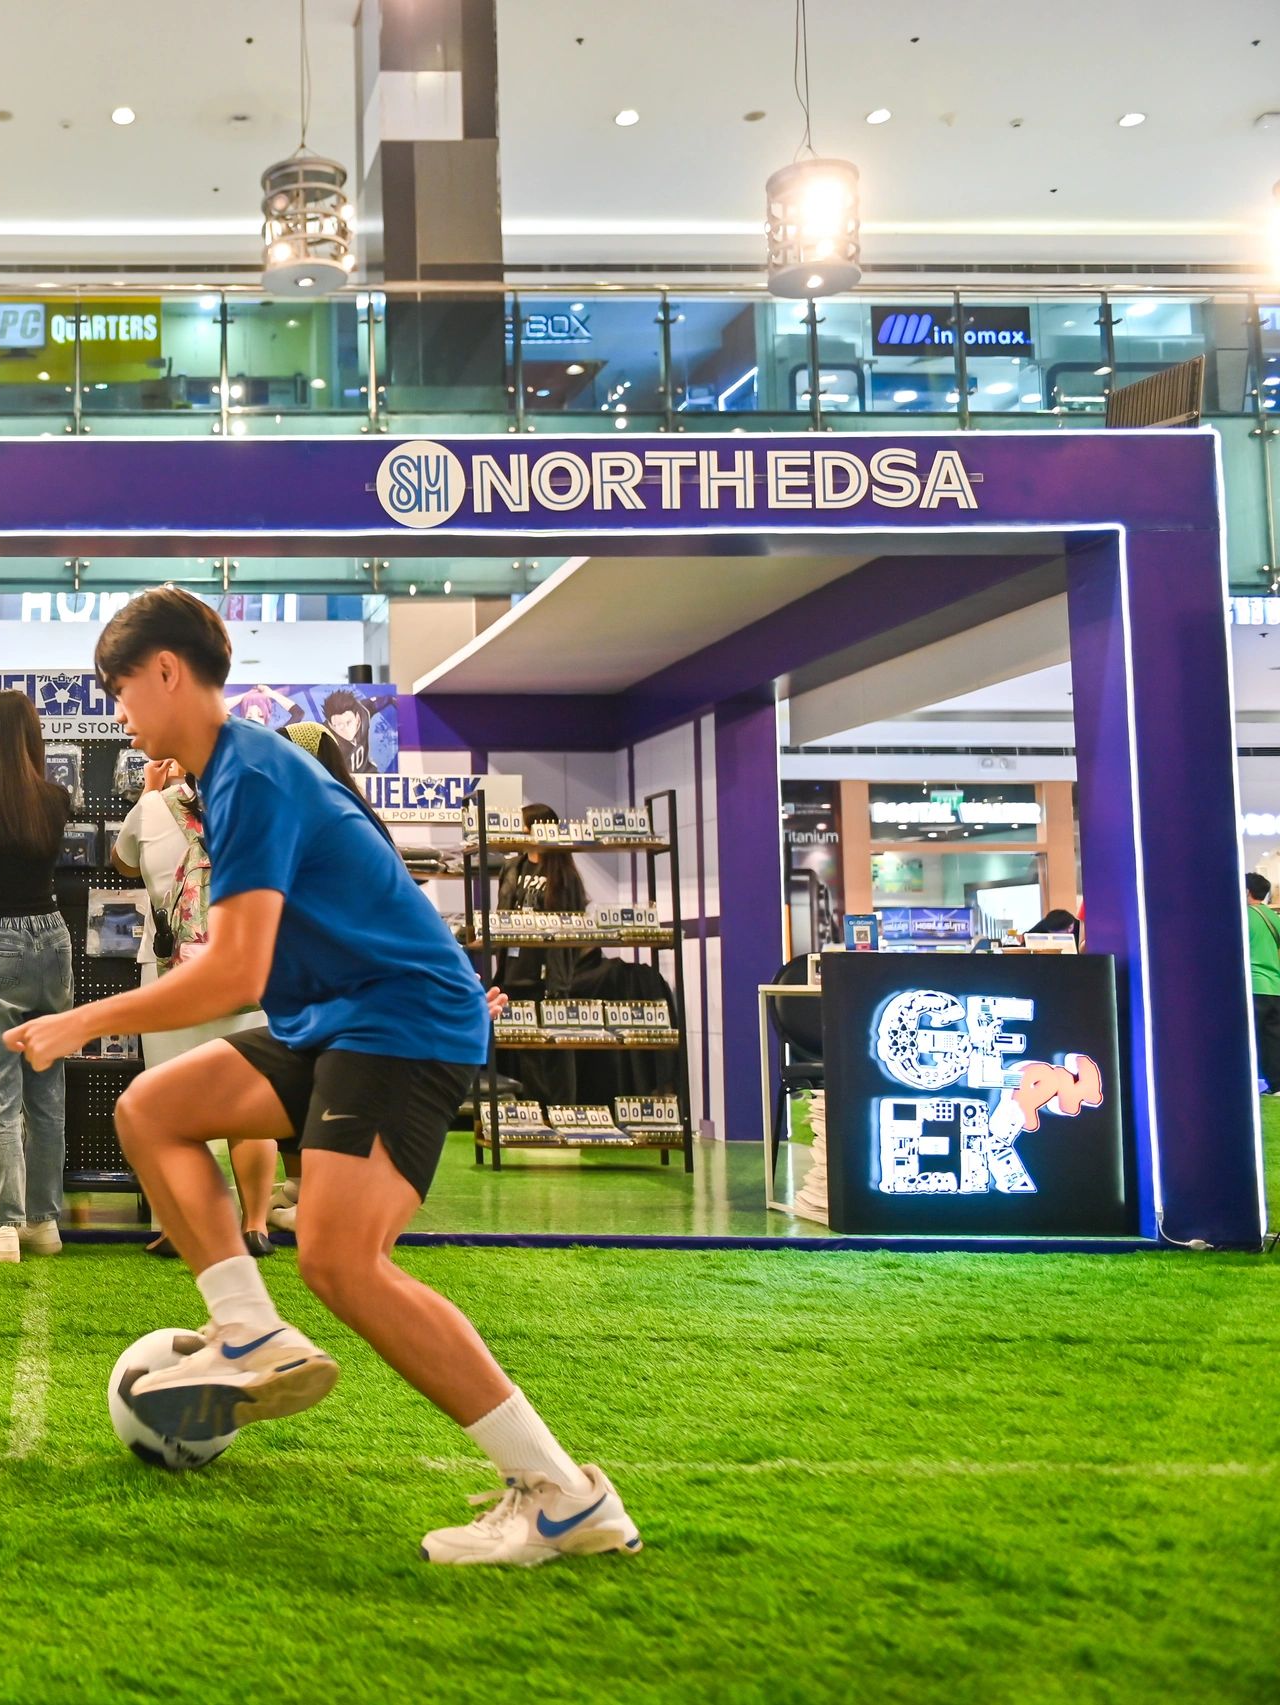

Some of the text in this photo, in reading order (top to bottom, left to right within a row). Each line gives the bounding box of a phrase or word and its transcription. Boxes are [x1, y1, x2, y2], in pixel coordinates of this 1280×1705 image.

[51, 314, 158, 344] QUARTERS
[525, 314, 592, 338] BOX
[933, 326, 1025, 345] inomax
[472, 450, 754, 513] NORTH
[767, 447, 979, 511] EDSA
[52, 722, 72, 734] UP
[365, 776, 482, 809] UELOCK
[392, 811, 417, 821] POP
[420, 811, 435, 821] UP
[438, 811, 461, 821] STO
